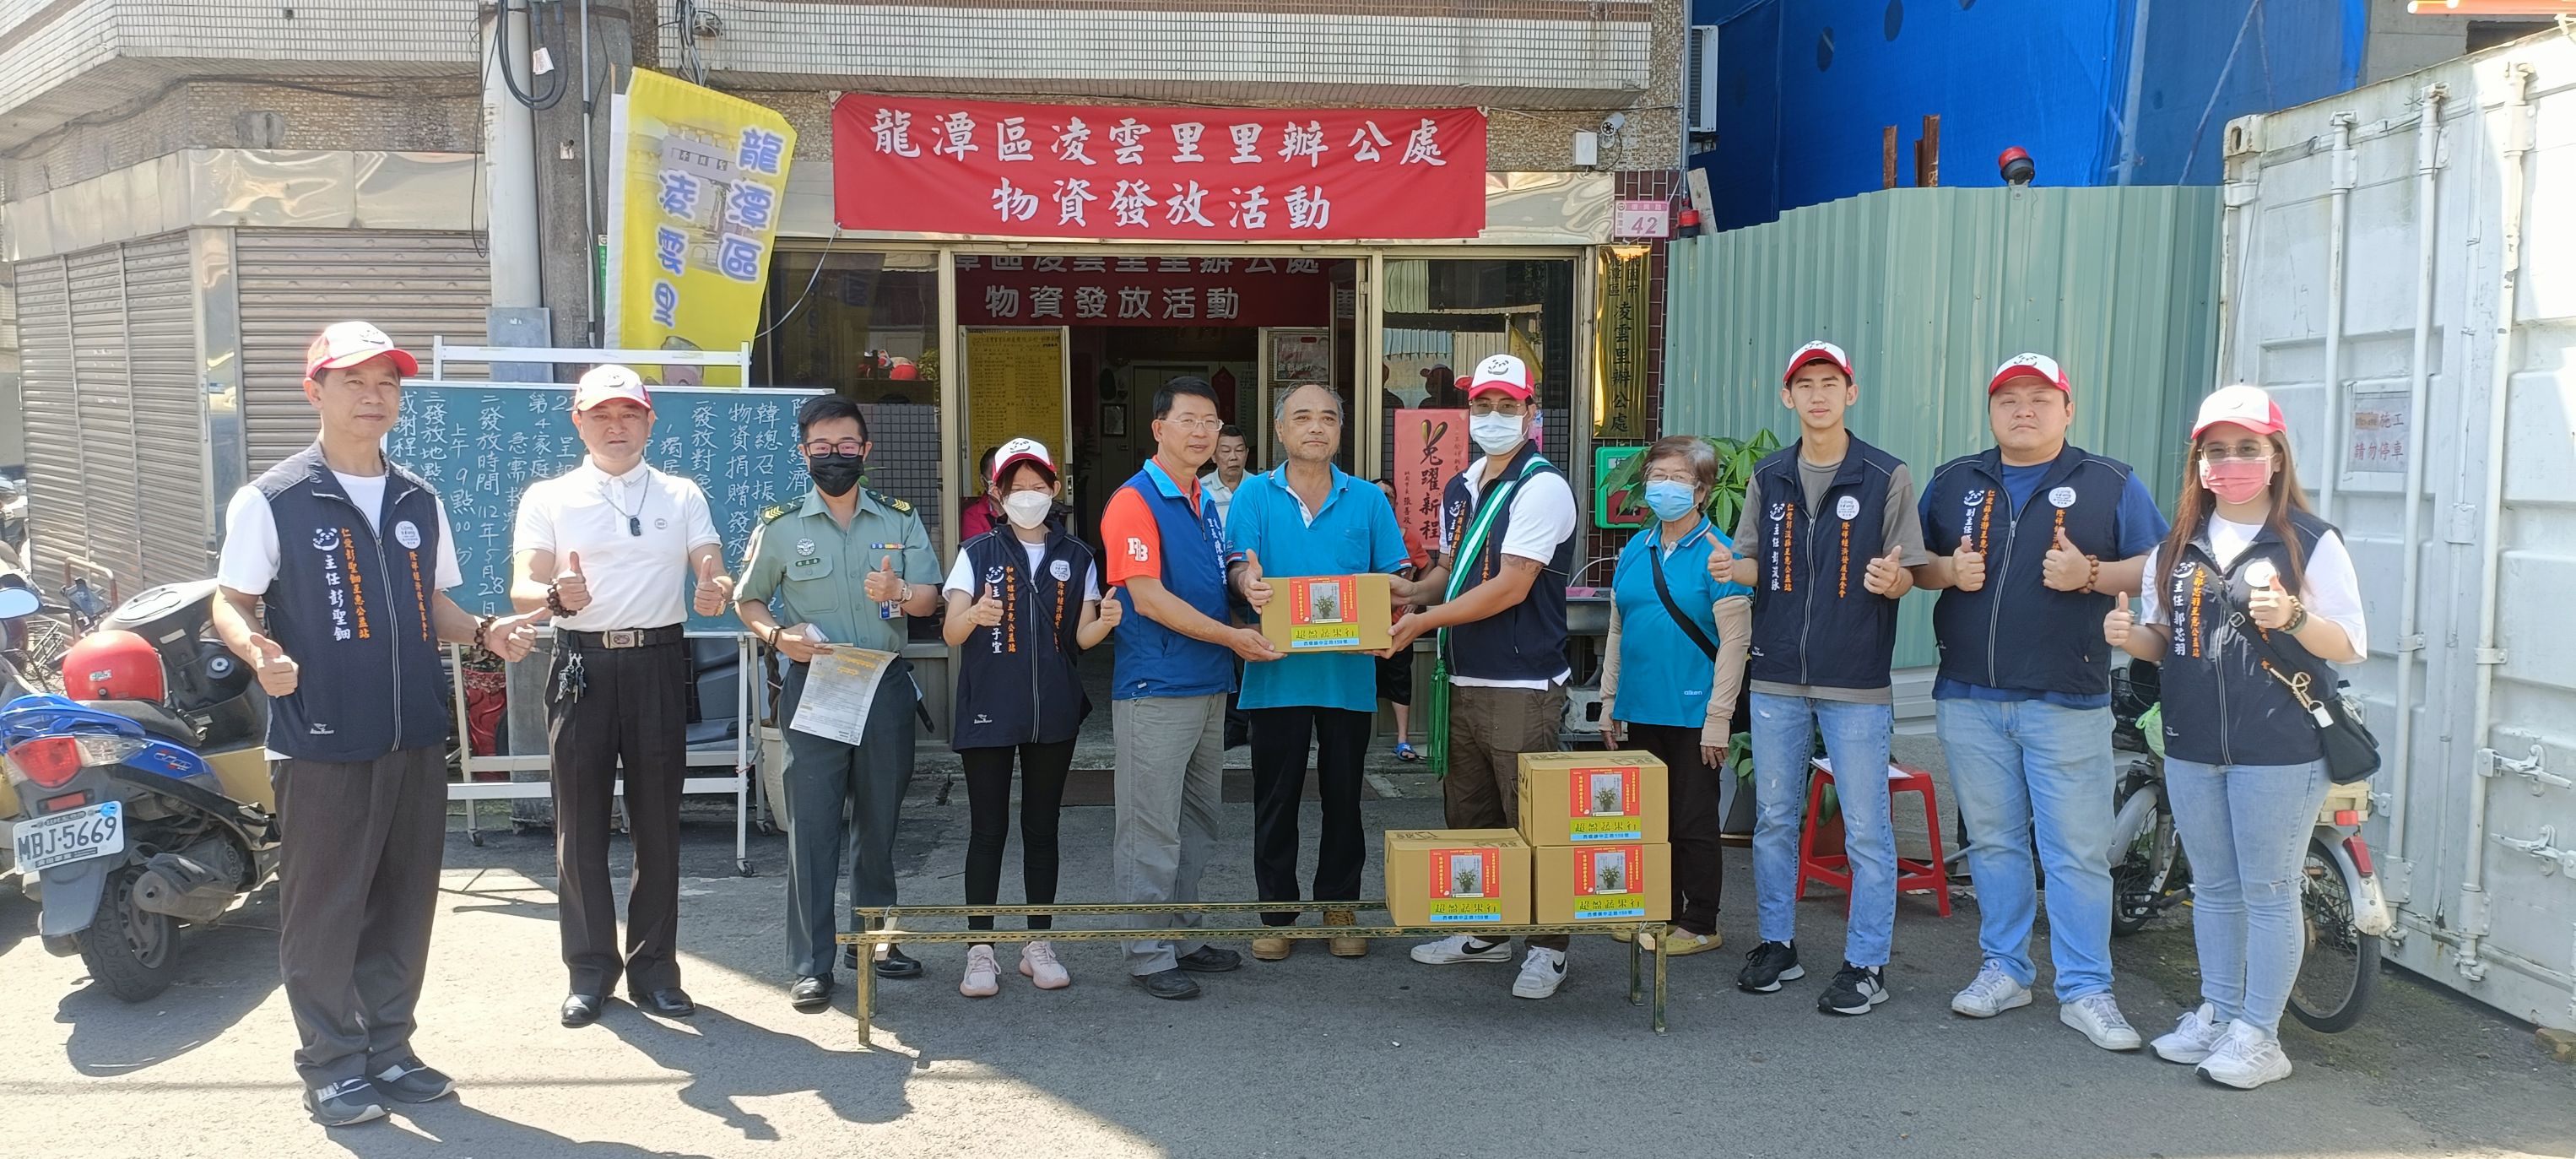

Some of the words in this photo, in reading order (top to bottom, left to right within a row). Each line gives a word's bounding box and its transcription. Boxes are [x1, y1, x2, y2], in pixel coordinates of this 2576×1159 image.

[869, 107, 1449, 167] 龍潭區凌雲里里辦公處
[719, 128, 783, 282] 龍潭區
[991, 176, 1331, 230] 物資發放活動
[1631, 216, 1658, 234] 42
[653, 170, 700, 329] 凌雲里
[984, 284, 1239, 320] 物資發放活動
[1611, 301, 1632, 432] 凌雲里辦公處
[1420, 420, 1448, 541] 兔躍新程
[2355, 440, 2404, 461] 請勿停車
[325, 555, 351, 642] 主任彭聖鈿
[991, 586, 1003, 654] 主子宜
[2173, 580, 2186, 656] 主任郭芯羽
